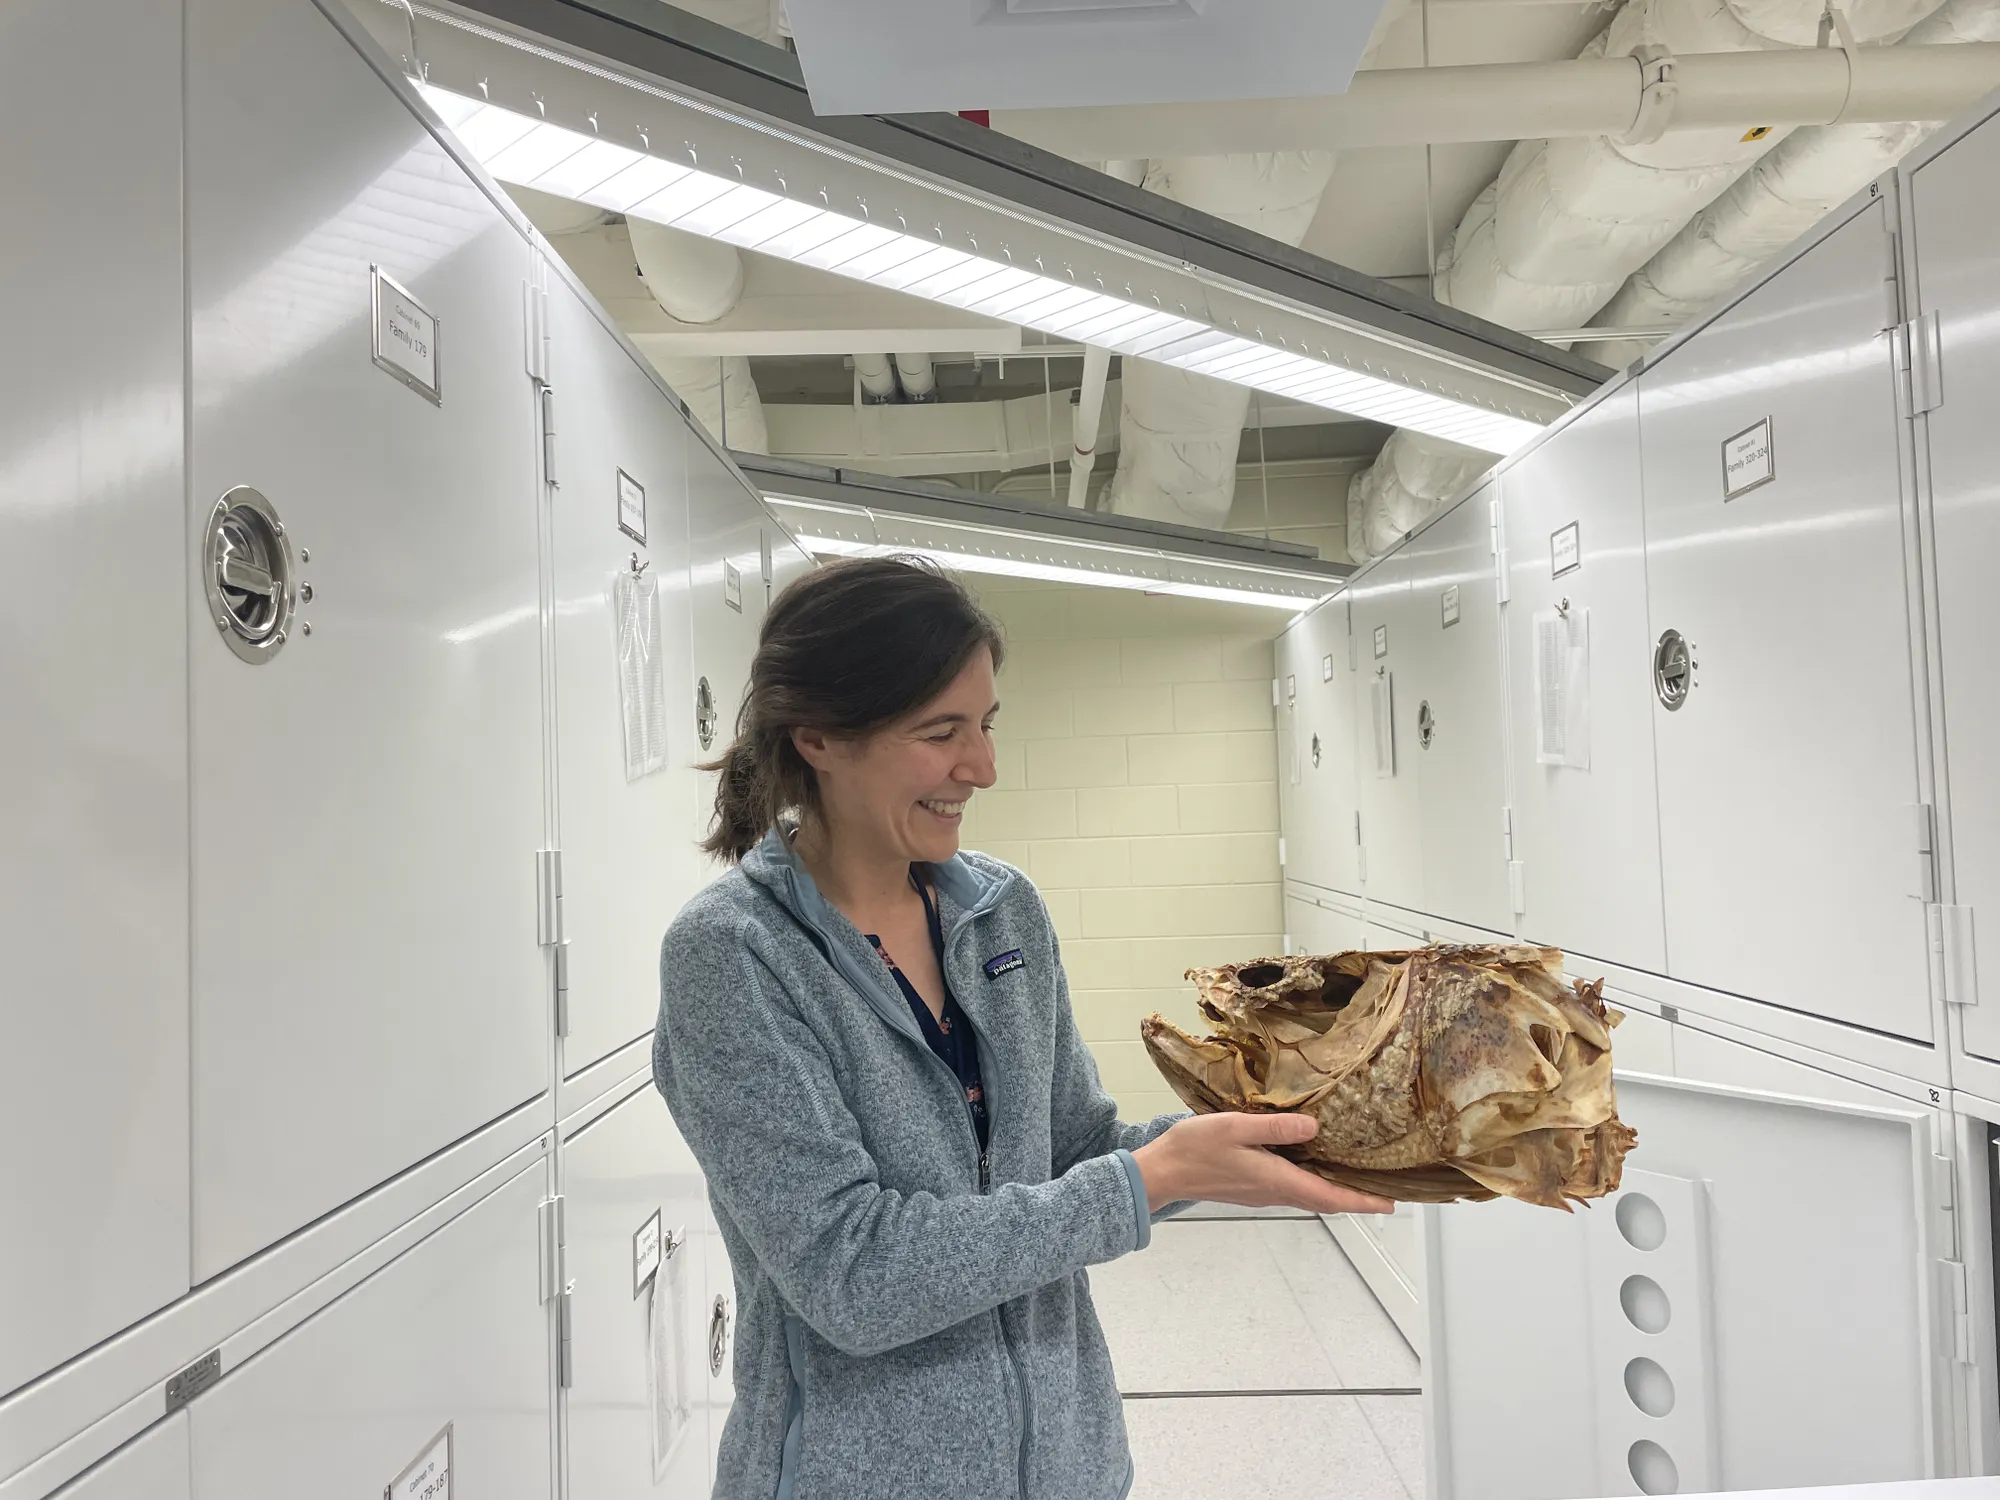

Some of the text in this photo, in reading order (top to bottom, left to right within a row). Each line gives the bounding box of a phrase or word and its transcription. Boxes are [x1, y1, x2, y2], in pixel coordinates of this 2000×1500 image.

[1870, 181, 1879, 198] 81
[389, 319, 427, 358] Family 179
[1728, 446, 1768, 474] Family 320-324
[1928, 1088, 1940, 1103] 82
